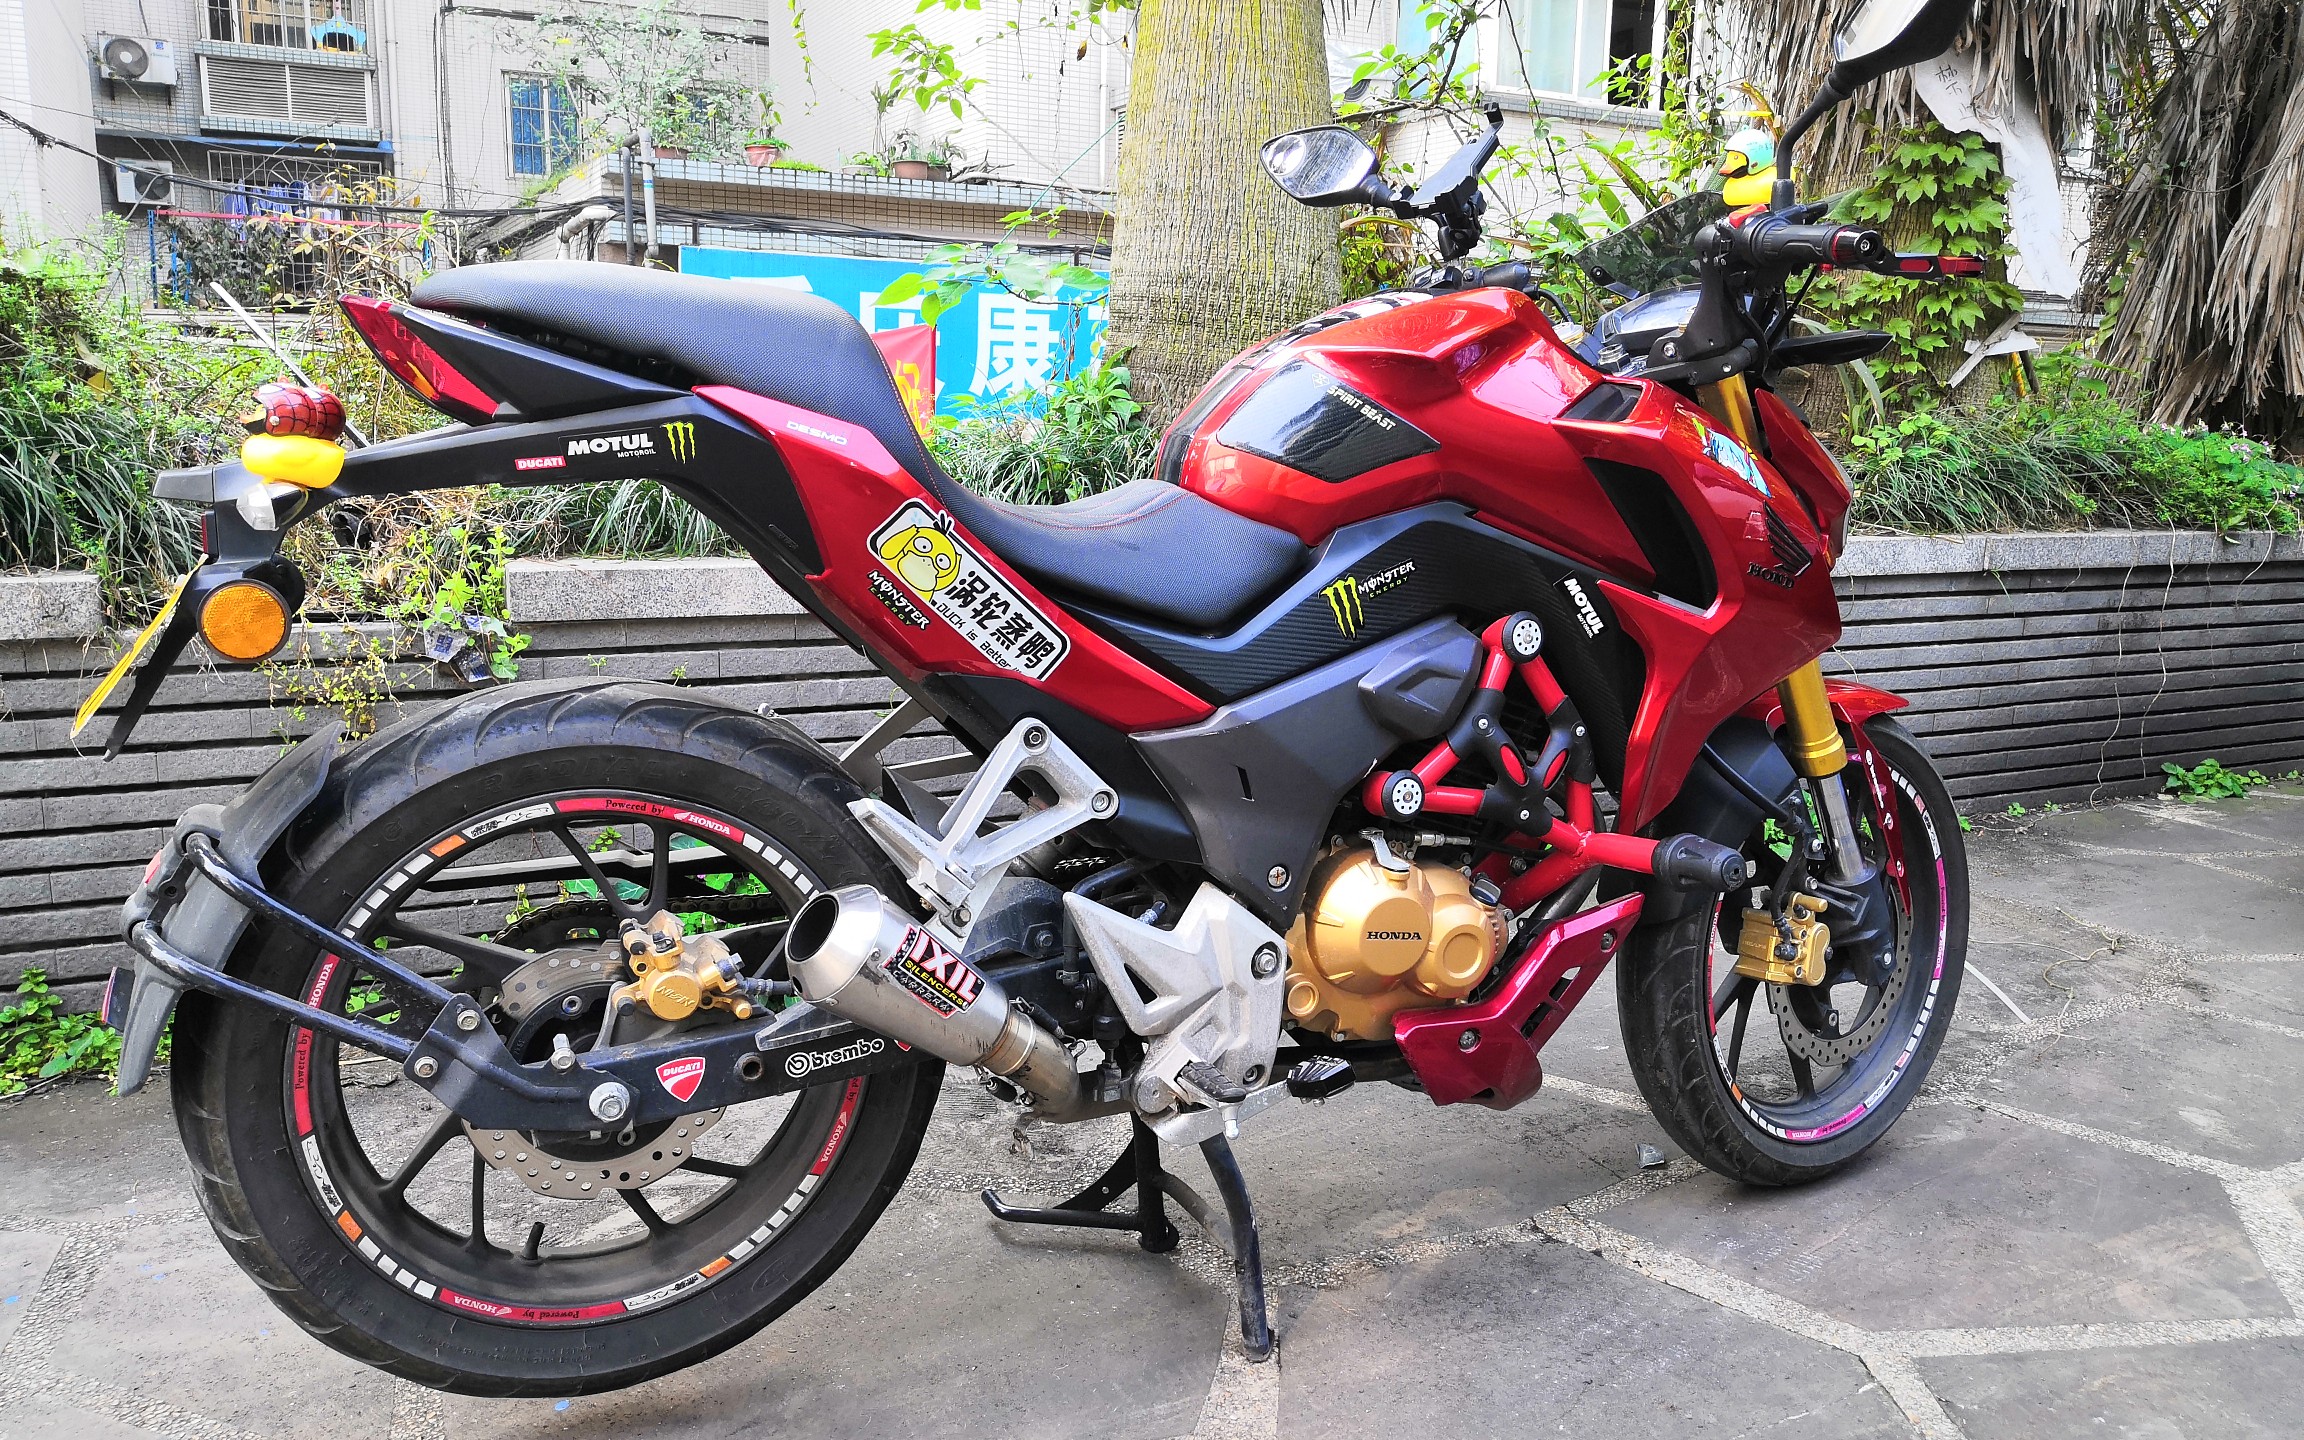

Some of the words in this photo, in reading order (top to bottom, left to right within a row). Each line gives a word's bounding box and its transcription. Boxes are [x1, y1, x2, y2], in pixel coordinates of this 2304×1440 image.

[1326, 384, 1363, 409] SPIRIT
[1360, 404, 1396, 431] BEAST
[567, 432, 654, 456] MOTUL
[786, 420, 848, 446] DESMO
[517, 457, 563, 470] DUCATI
[617, 448, 657, 459] MOTOROIL
[1357, 561, 1416, 595] MONSTER
[868, 570, 930, 630] MONSTER
[1563, 577, 1604, 636] MOTUL
[944, 570, 1056, 669] 涡轮蒸鸭
[1576, 613, 1594, 639] MOTOROIL
[966, 628, 979, 641] is
[980, 640, 1011, 668] Better
[605, 799, 647, 812] Powered
[651, 805, 665, 816] by
[687, 813, 731, 836] HONDA
[1366, 931, 1422, 941] HONDA
[905, 959, 964, 1006] SILENCERS
[909, 929, 977, 1003] IXIL
[308, 962, 333, 1009] HONDA
[299, 1032, 311, 1045] by
[807, 1037, 885, 1071] brembo
[294, 1049, 307, 1090] Powered
[662, 1061, 701, 1076] DUCATI
[820, 1124, 844, 1163] HONDA
[453, 1296, 498, 1316] HONDA
[540, 1310, 580, 1320] Powered
